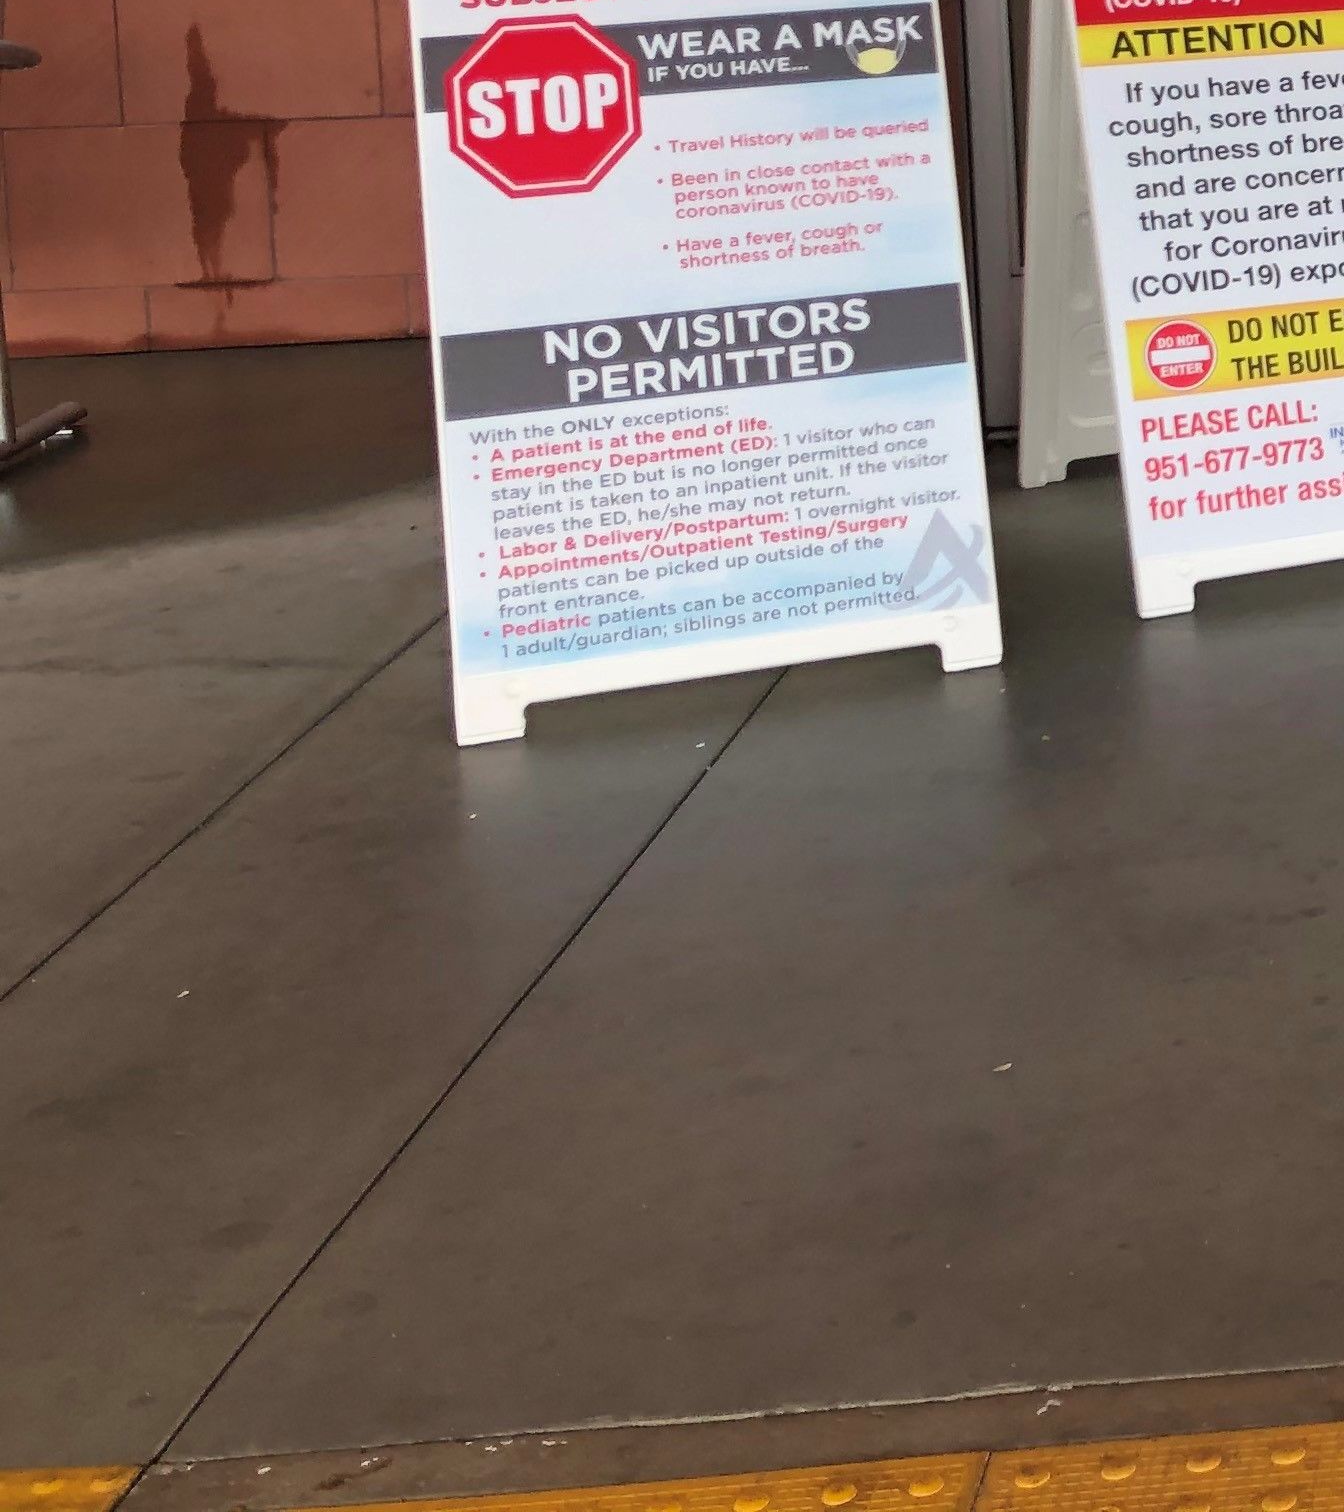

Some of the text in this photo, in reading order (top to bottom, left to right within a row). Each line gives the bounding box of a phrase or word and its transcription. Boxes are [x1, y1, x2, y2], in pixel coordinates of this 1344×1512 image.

[637, 13, 924, 61] WEAR A MASK
[1112, 19, 1323, 58] ATTENTION
[648, 66, 668, 82] IF
[676, 62, 722, 79] YOU
[466, 73, 620, 139] STOP
[1126, 82, 1142, 102] If
[1151, 84, 1199, 106] you
[1208, 77, 1270, 96] have
[1279, 77, 1294, 92] a
[1109, 111, 1200, 137] cough,
[1209, 110, 1266, 128] sore
[1127, 142, 1259, 167] shortness
[1268, 134, 1292, 155] of
[676, 222, 882, 252] Have a fever, cough or
[680, 239, 864, 268] shortness of breath.
[540, 295, 874, 363] NO VISITORS
[1228, 317, 1262, 343] DO
[1271, 311, 1319, 338] NOT
[564, 336, 858, 405] PERMITTED
[1231, 354, 1280, 381] THE
[469, 405, 728, 445] With the ONLY exceptions:
[1141, 400, 1317, 442] PLEASE CALL:
[1145, 437, 1324, 481] 951-677-9773
[1149, 496, 1186, 520] for
[1196, 484, 1287, 514] further
